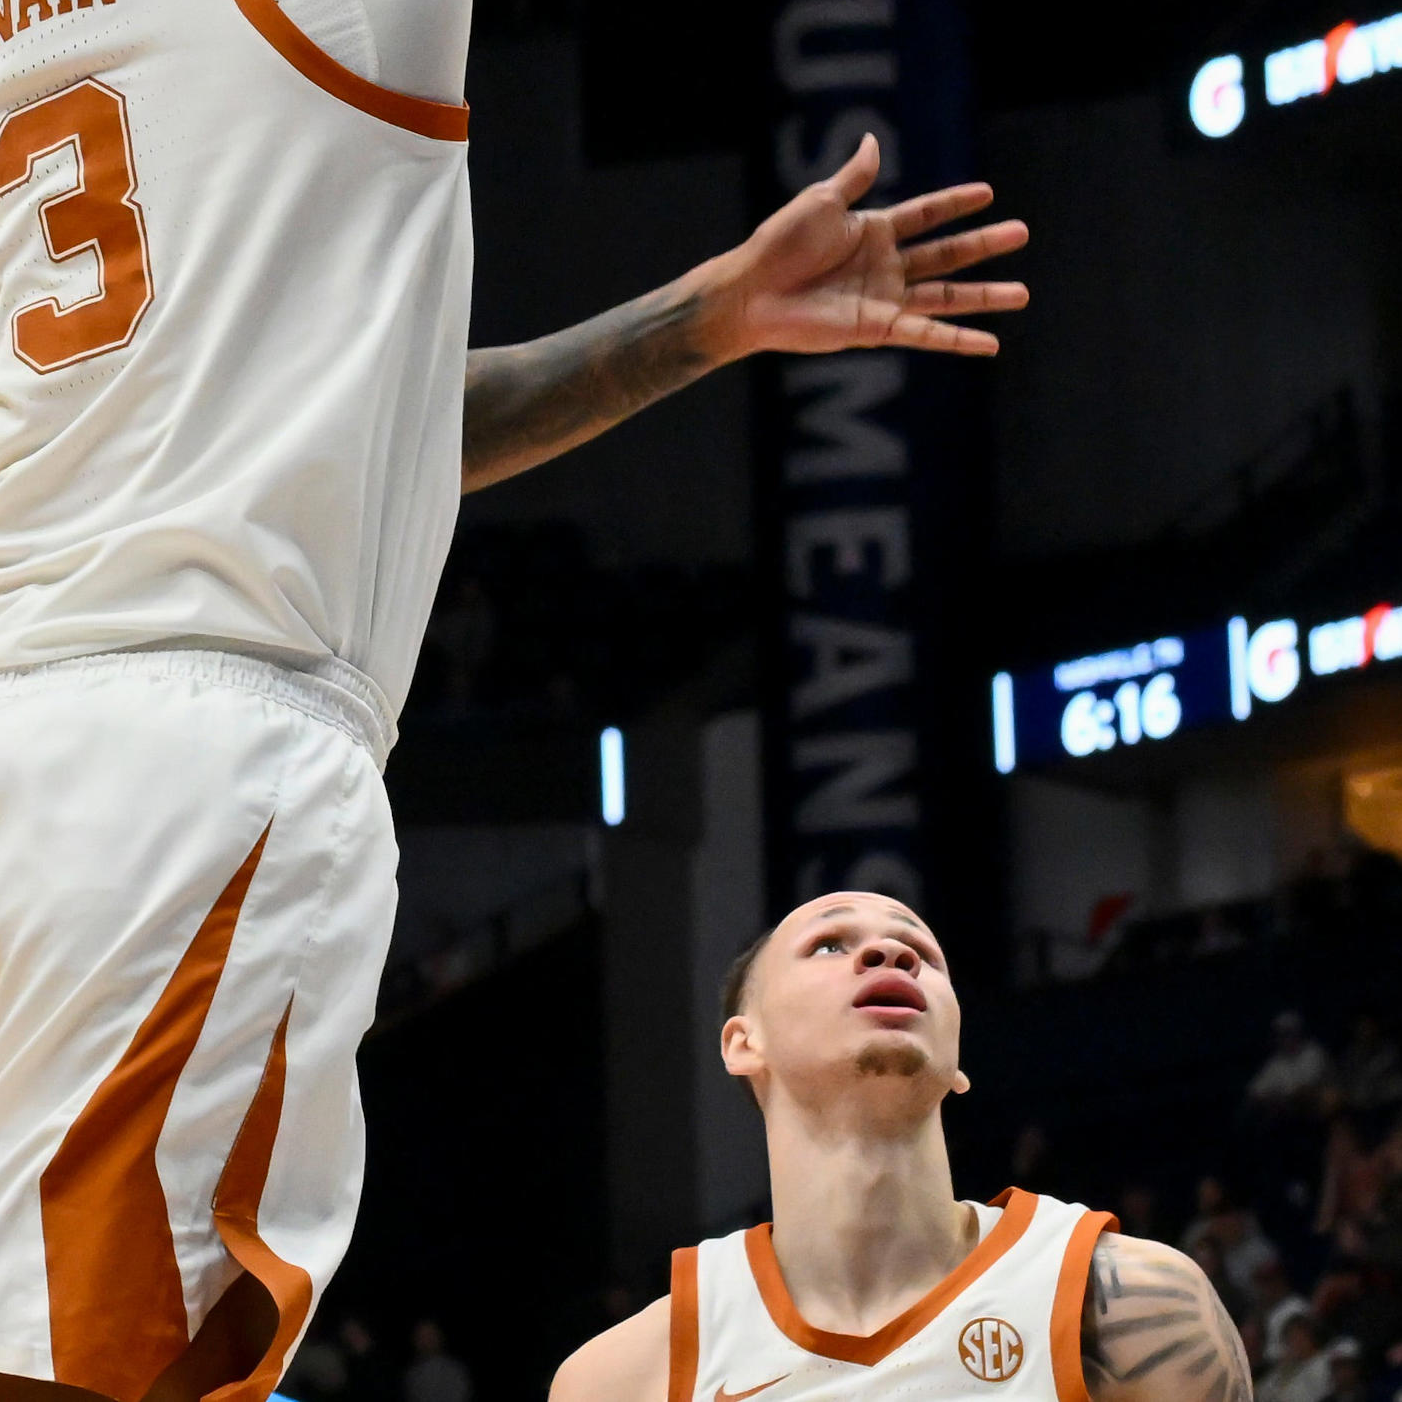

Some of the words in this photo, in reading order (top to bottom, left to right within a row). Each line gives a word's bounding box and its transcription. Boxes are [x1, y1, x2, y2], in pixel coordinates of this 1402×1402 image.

[1189, 54, 1245, 137] G
[1247, 619, 1300, 702] G
[1061, 673, 1181, 756] 6:16
[962, 1320, 1019, 1378] SEC
